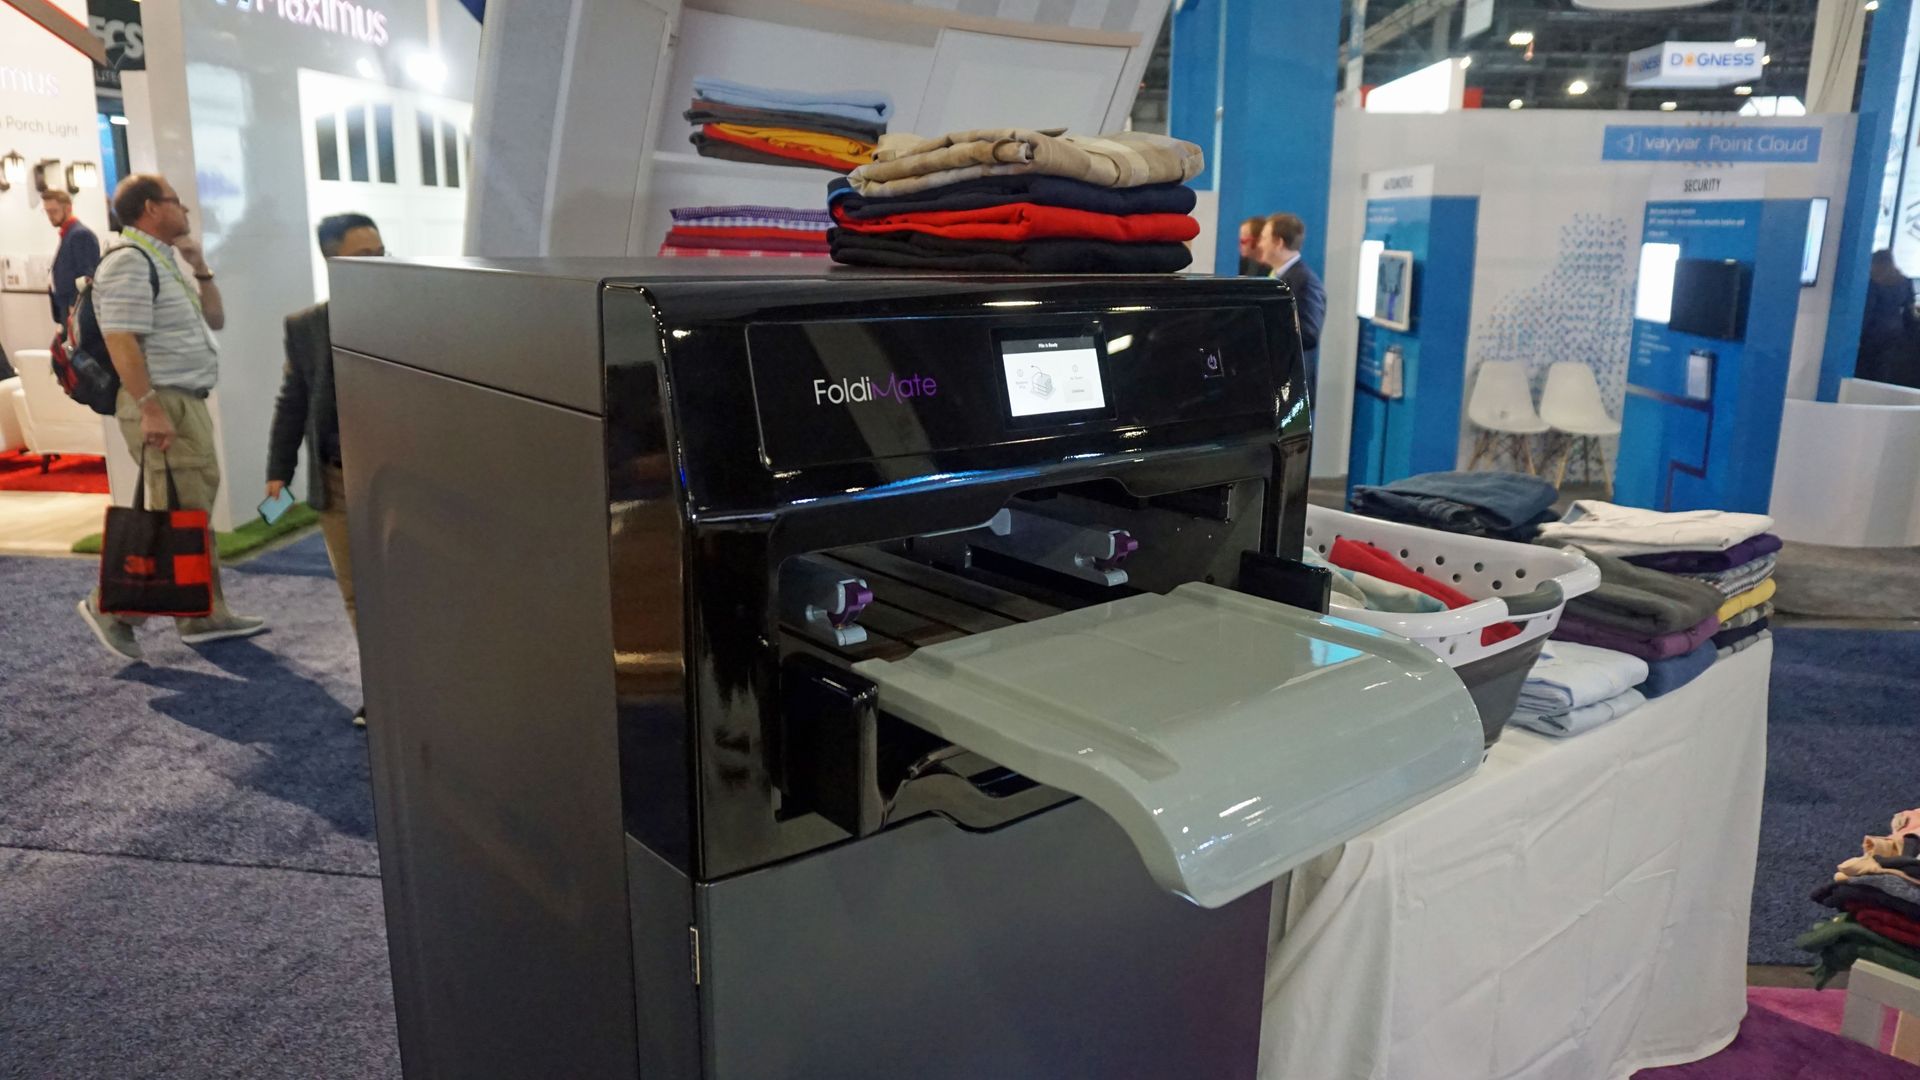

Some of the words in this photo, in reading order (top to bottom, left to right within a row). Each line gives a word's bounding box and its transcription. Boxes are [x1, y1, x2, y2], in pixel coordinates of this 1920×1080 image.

[6, 115, 44, 133] Porch
[48, 119, 79, 138] Light
[1645, 136, 1700, 153] vayyar
[1709, 134, 1753, 150] Point
[1757, 134, 1809, 152] Cloud
[1683, 178, 1722, 193] SECURITY
[813, 371, 937, 406] FoldiMate
